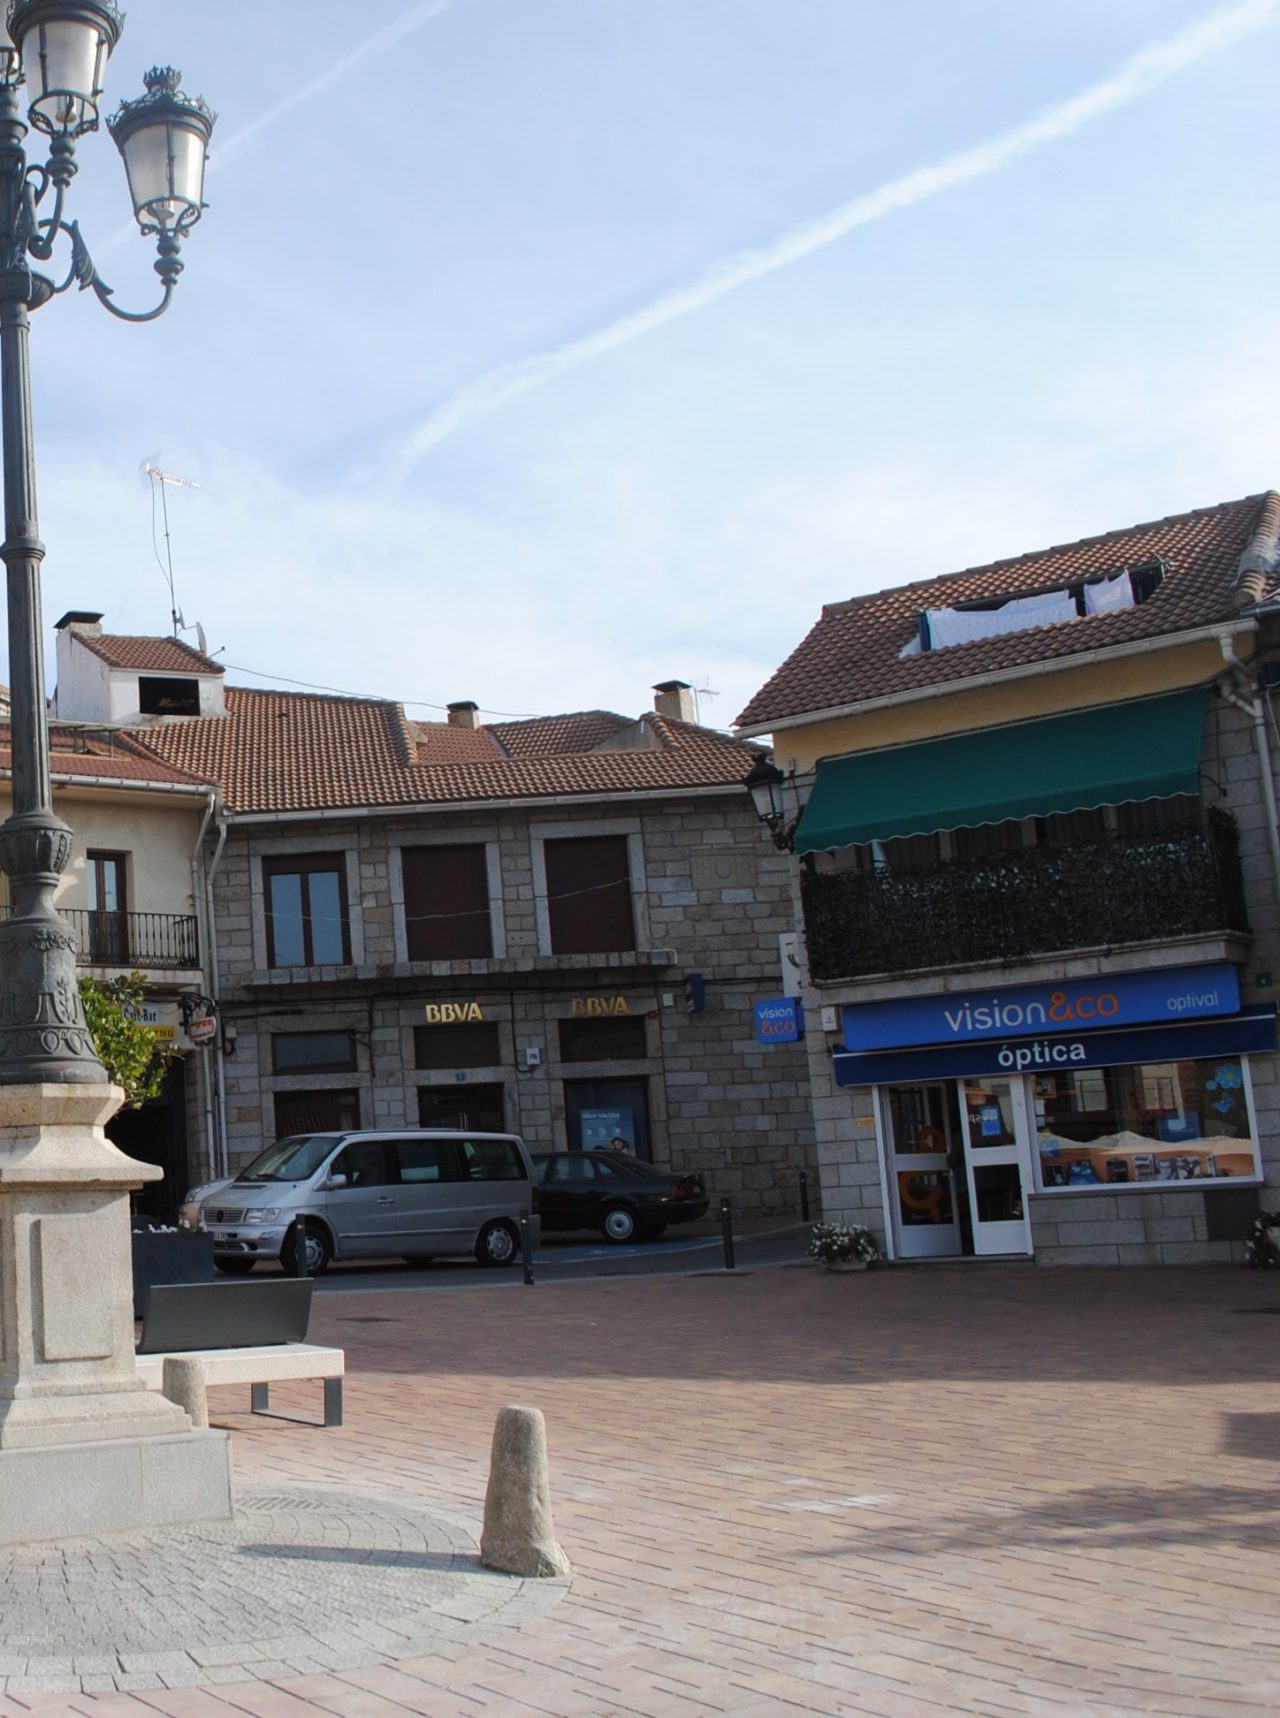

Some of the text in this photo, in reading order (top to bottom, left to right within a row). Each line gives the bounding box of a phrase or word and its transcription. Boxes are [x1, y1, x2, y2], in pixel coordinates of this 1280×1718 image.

[426, 1002, 484, 1024] BBVA
[571, 996, 630, 1018] BBVA
[944, 990, 1120, 1032] vision&co
[1167, 991, 1219, 1013] optival
[758, 1007, 793, 1020] vision
[761, 1020, 796, 1037] &co
[997, 1041, 1086, 1070] óptica
